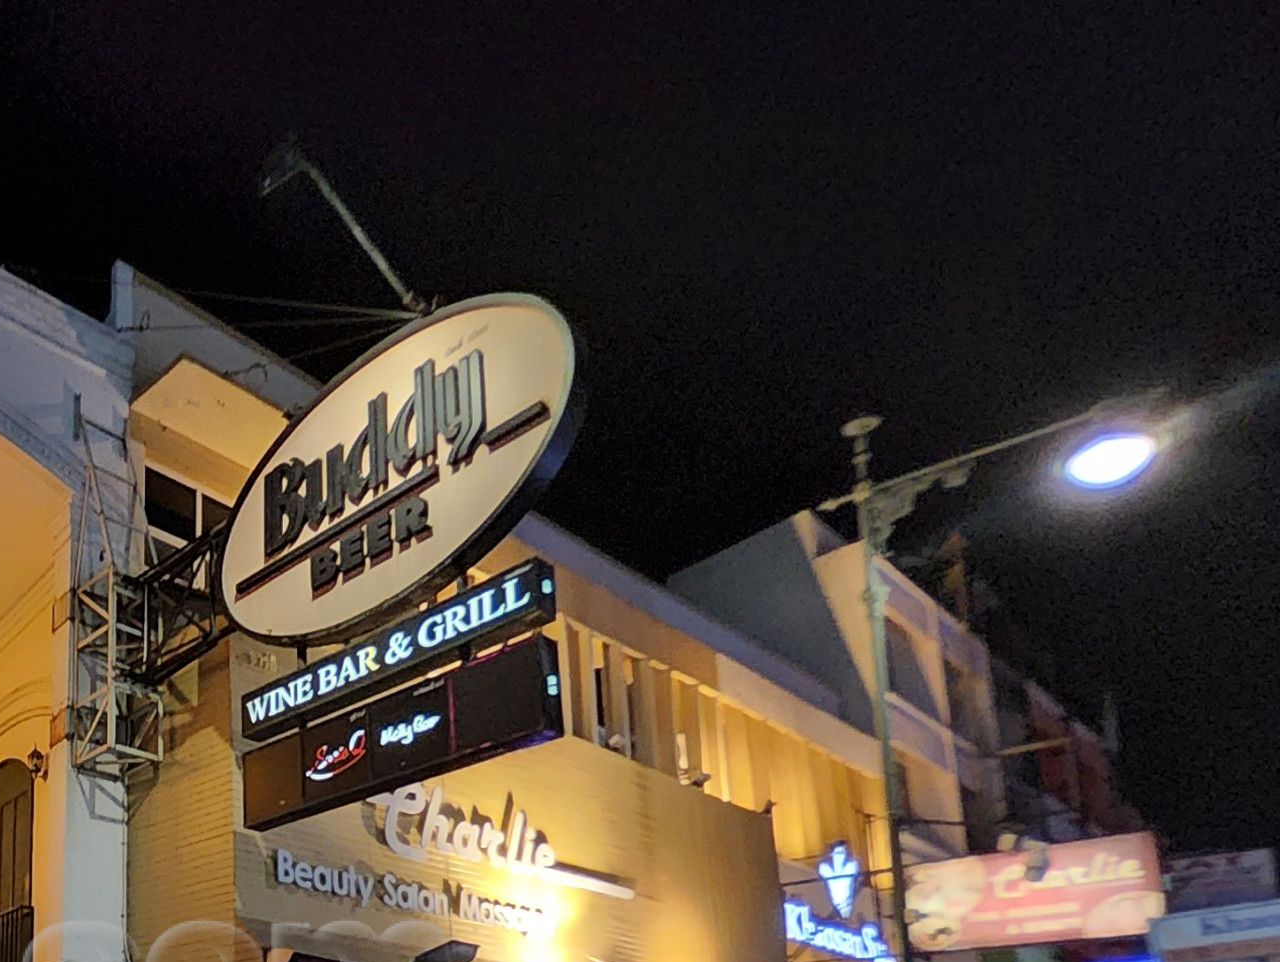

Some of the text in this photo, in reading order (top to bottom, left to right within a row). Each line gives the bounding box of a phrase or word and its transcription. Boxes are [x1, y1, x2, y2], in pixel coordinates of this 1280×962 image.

[264, 349, 488, 564] Buddy
[310, 495, 433, 601] BEER
[246, 674, 313, 725] WINE
[317, 645, 381, 695] BAR
[384, 631, 414, 665] &
[417, 577, 531, 648] GRILL
[366, 782, 558, 868] Charlie
[276, 848, 374, 908] Beauty
[383, 870, 451, 915] Salon
[993, 853, 1146, 899] Carlie
